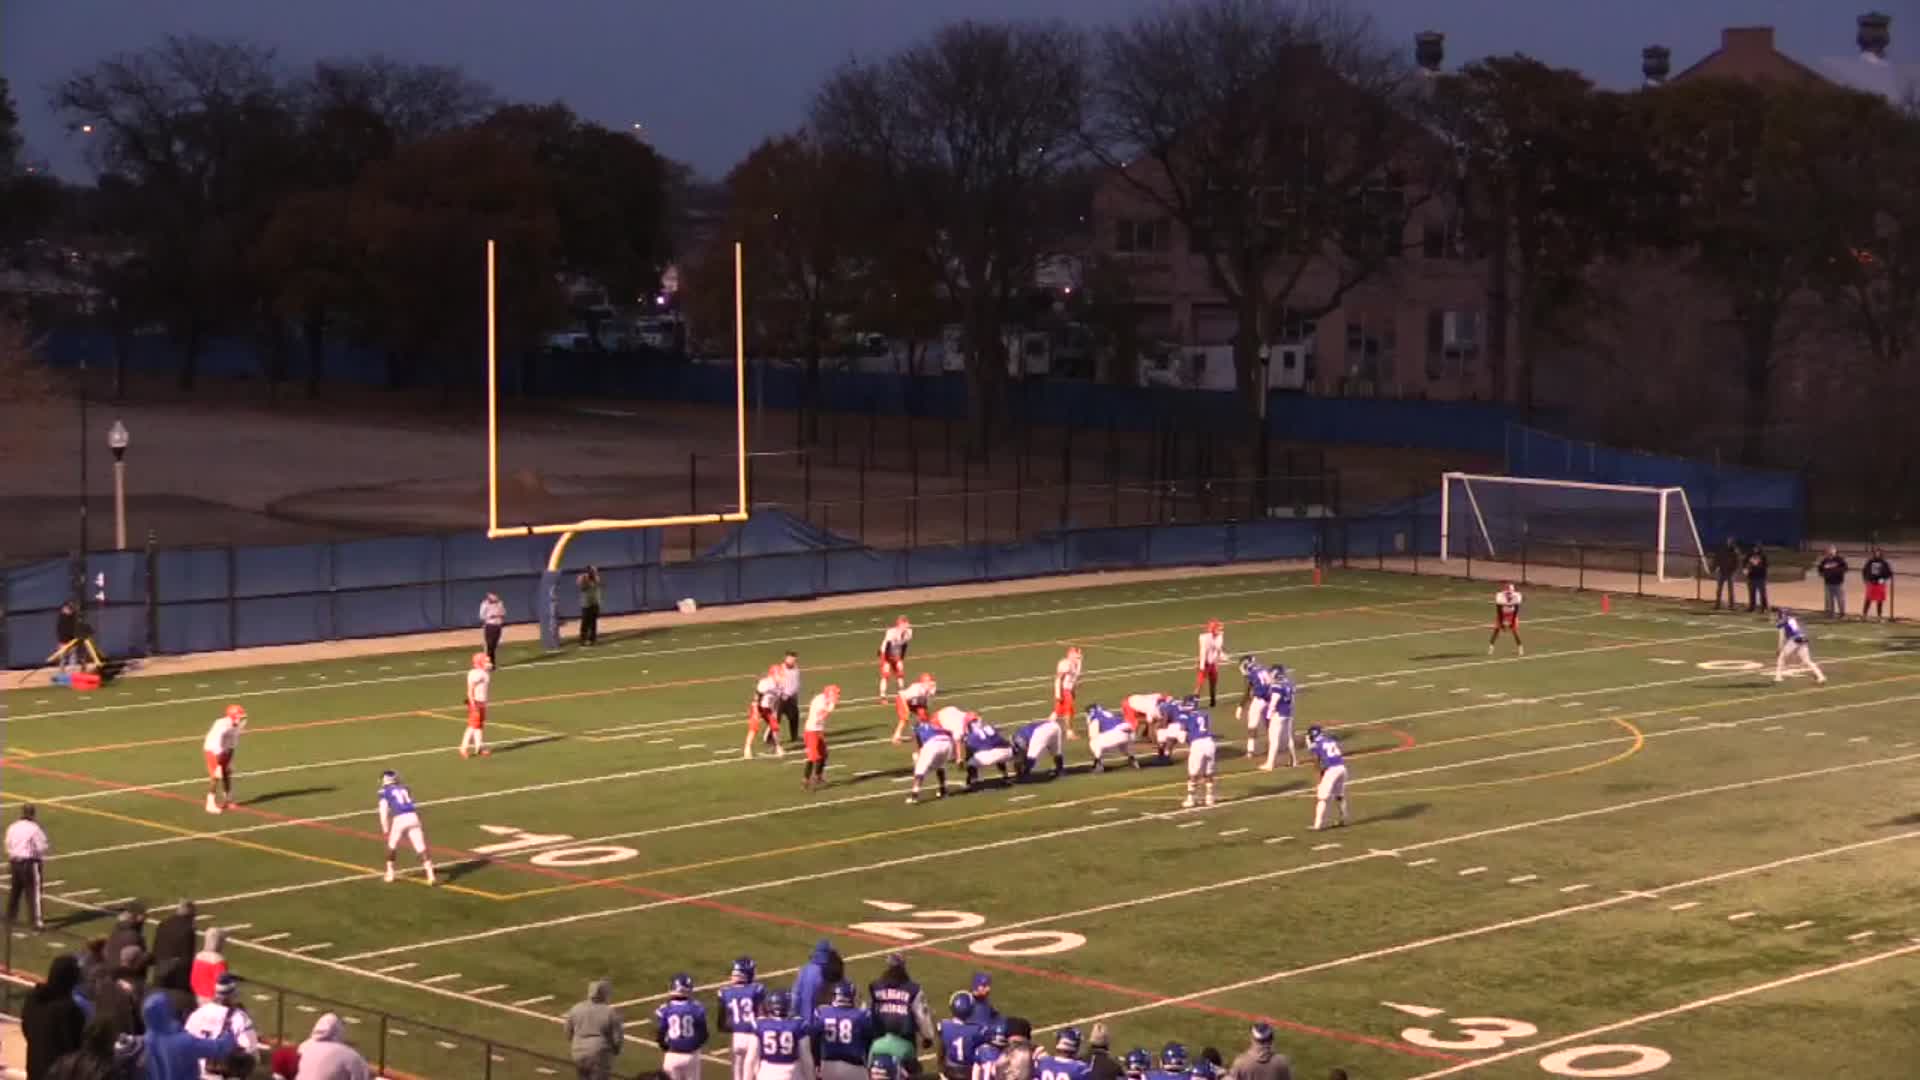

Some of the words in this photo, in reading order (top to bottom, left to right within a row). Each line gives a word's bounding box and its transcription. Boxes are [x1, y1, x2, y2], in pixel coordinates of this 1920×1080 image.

[847, 910, 1088, 956] 20
[728, 997, 754, 1024] 13
[763, 1030, 794, 1055] 59
[824, 1018, 852, 1043] 58
[952, 1036, 964, 1061] 1
[1400, 1016, 1672, 1077] 30
